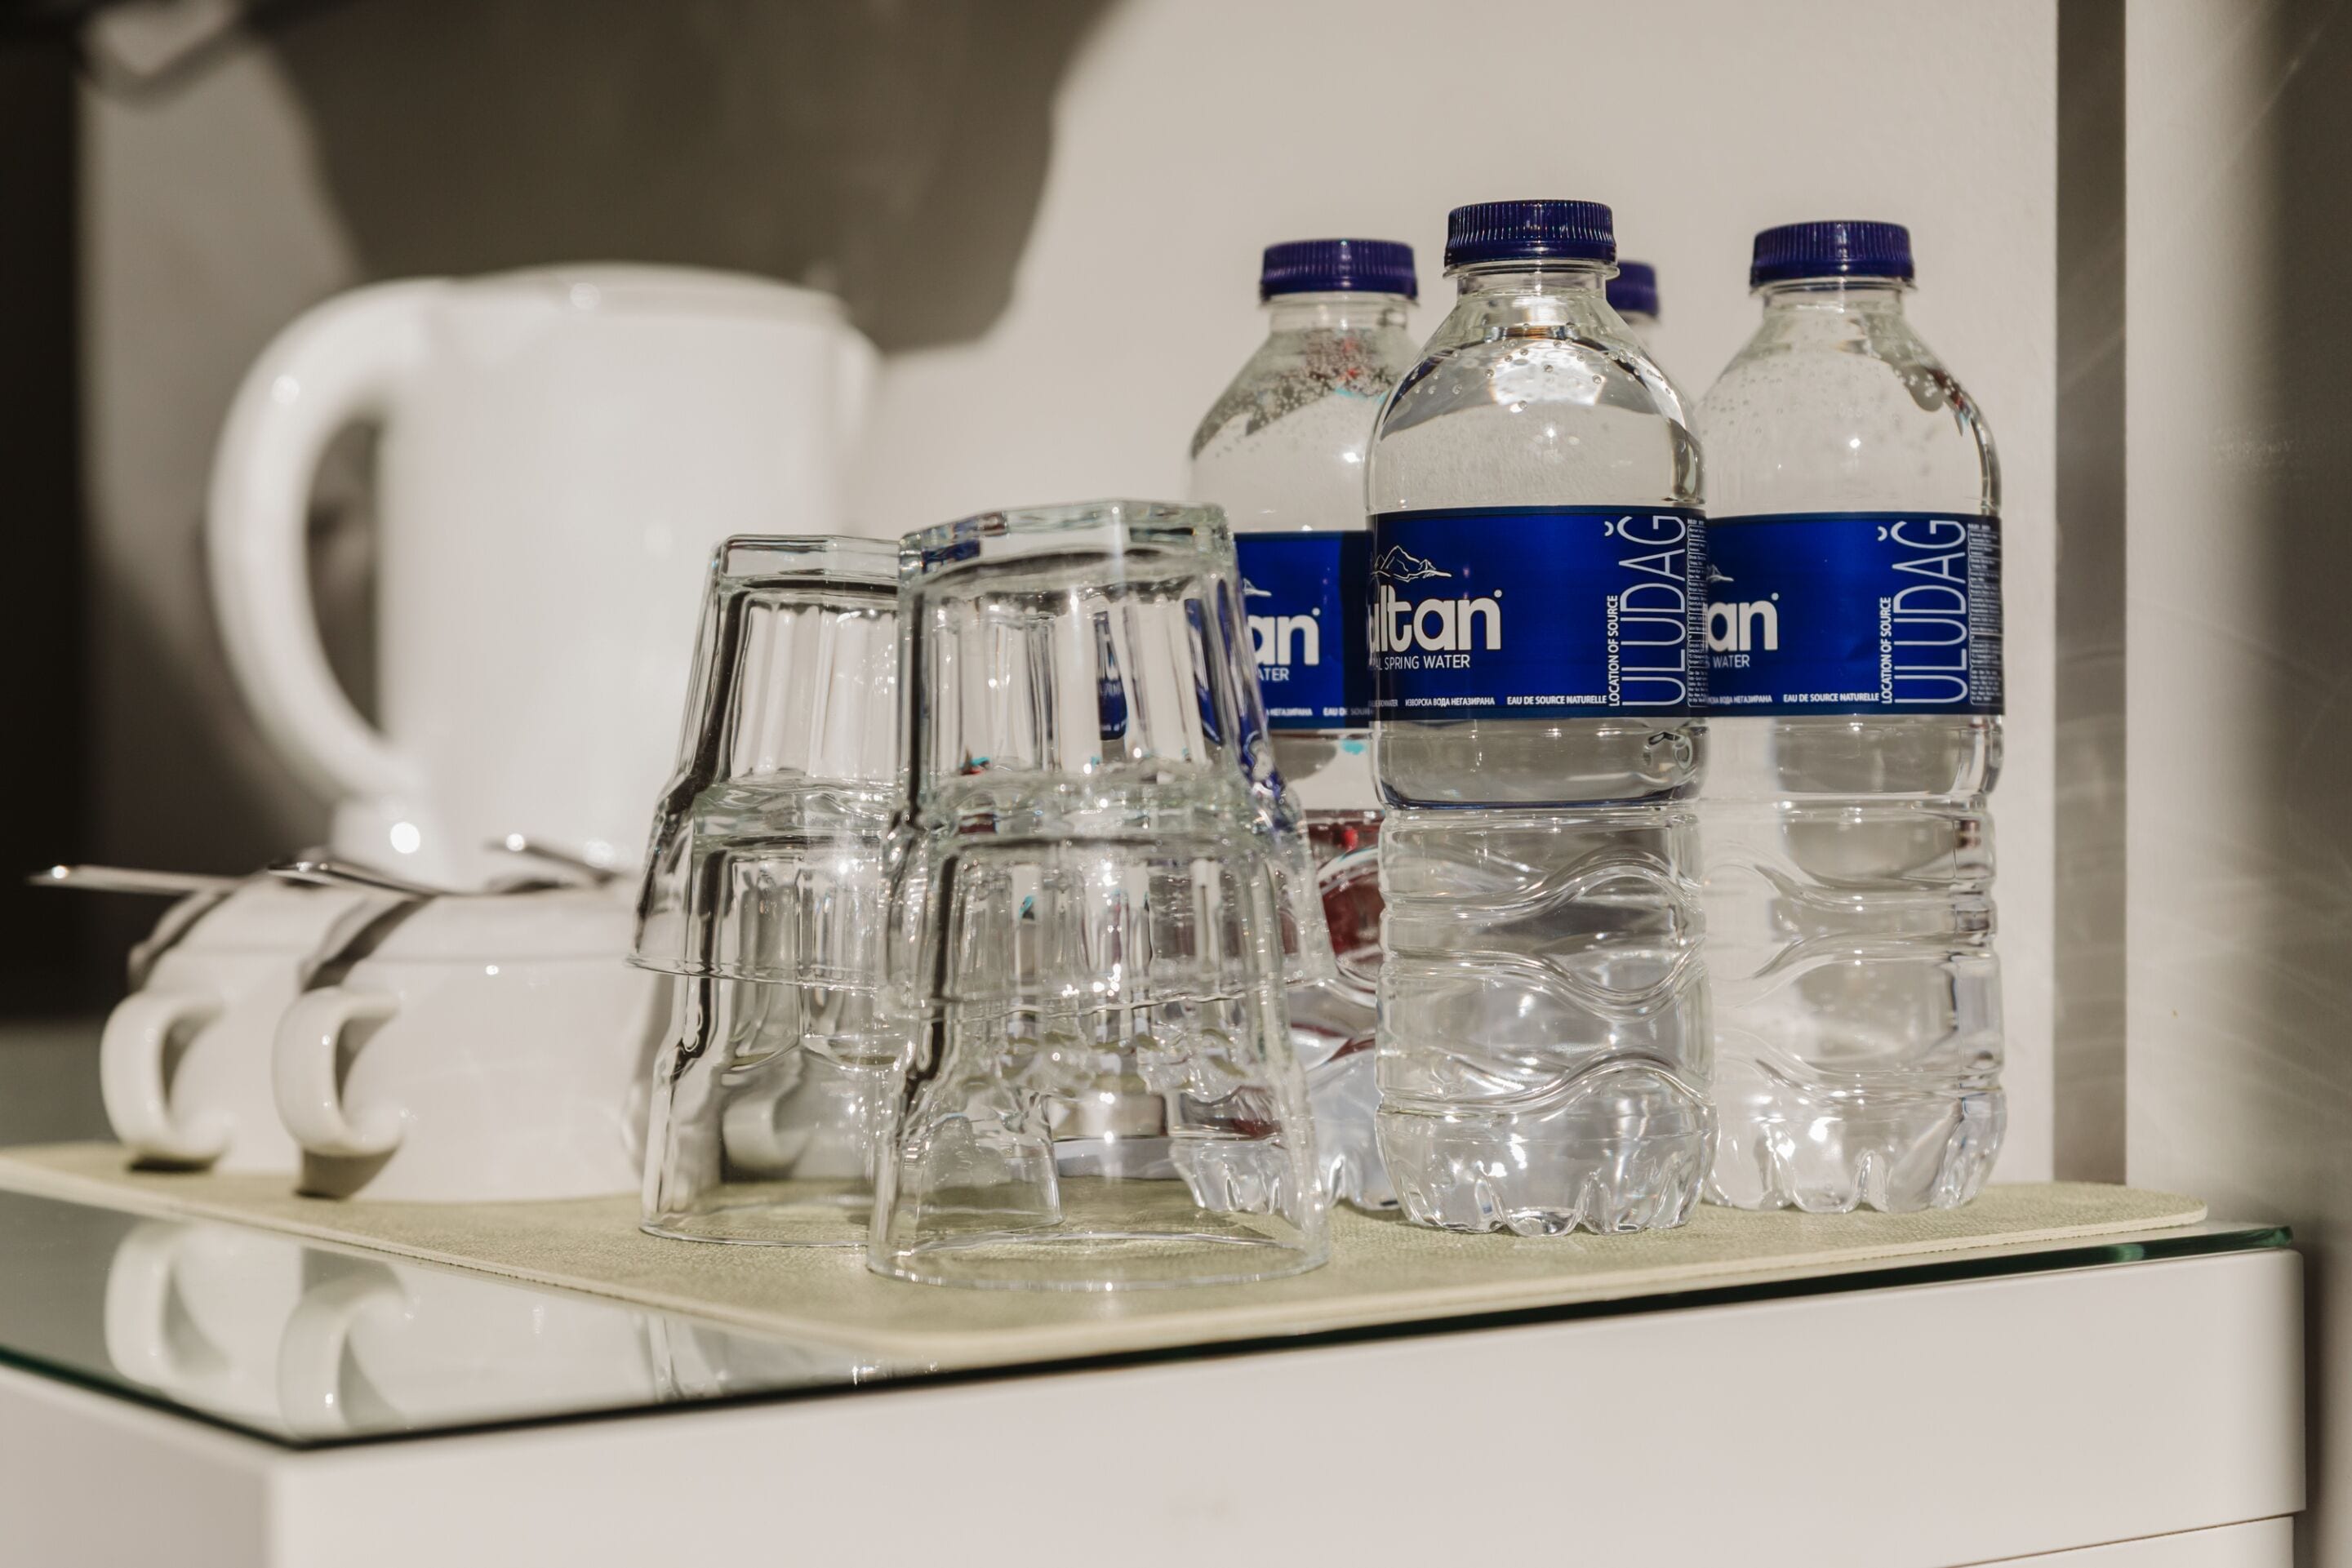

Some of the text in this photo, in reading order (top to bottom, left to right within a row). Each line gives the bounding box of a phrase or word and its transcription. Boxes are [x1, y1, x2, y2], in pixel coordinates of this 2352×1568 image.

[1604, 515, 1687, 706] ULUDAĞ
[1877, 519, 1967, 704] ULUDAĞ
[1607, 595, 1620, 707] LOCATION OF SOURCE
[1879, 597, 1892, 704] LOCATION OF SOURCE
[1384, 655, 1420, 671] SPRING
[1423, 654, 1470, 669] WATER
[1713, 654, 1750, 669] WATER
[1433, 698, 1451, 708] ВОДА
[1451, 696, 1496, 707] НЕГАЗИРАНА
[1506, 695, 1607, 705] EAU DE SOURCE NATURELLE
[1783, 692, 1880, 703] EAU DE SOURCE NATURELLE
[1323, 707, 1337, 717] EAU
